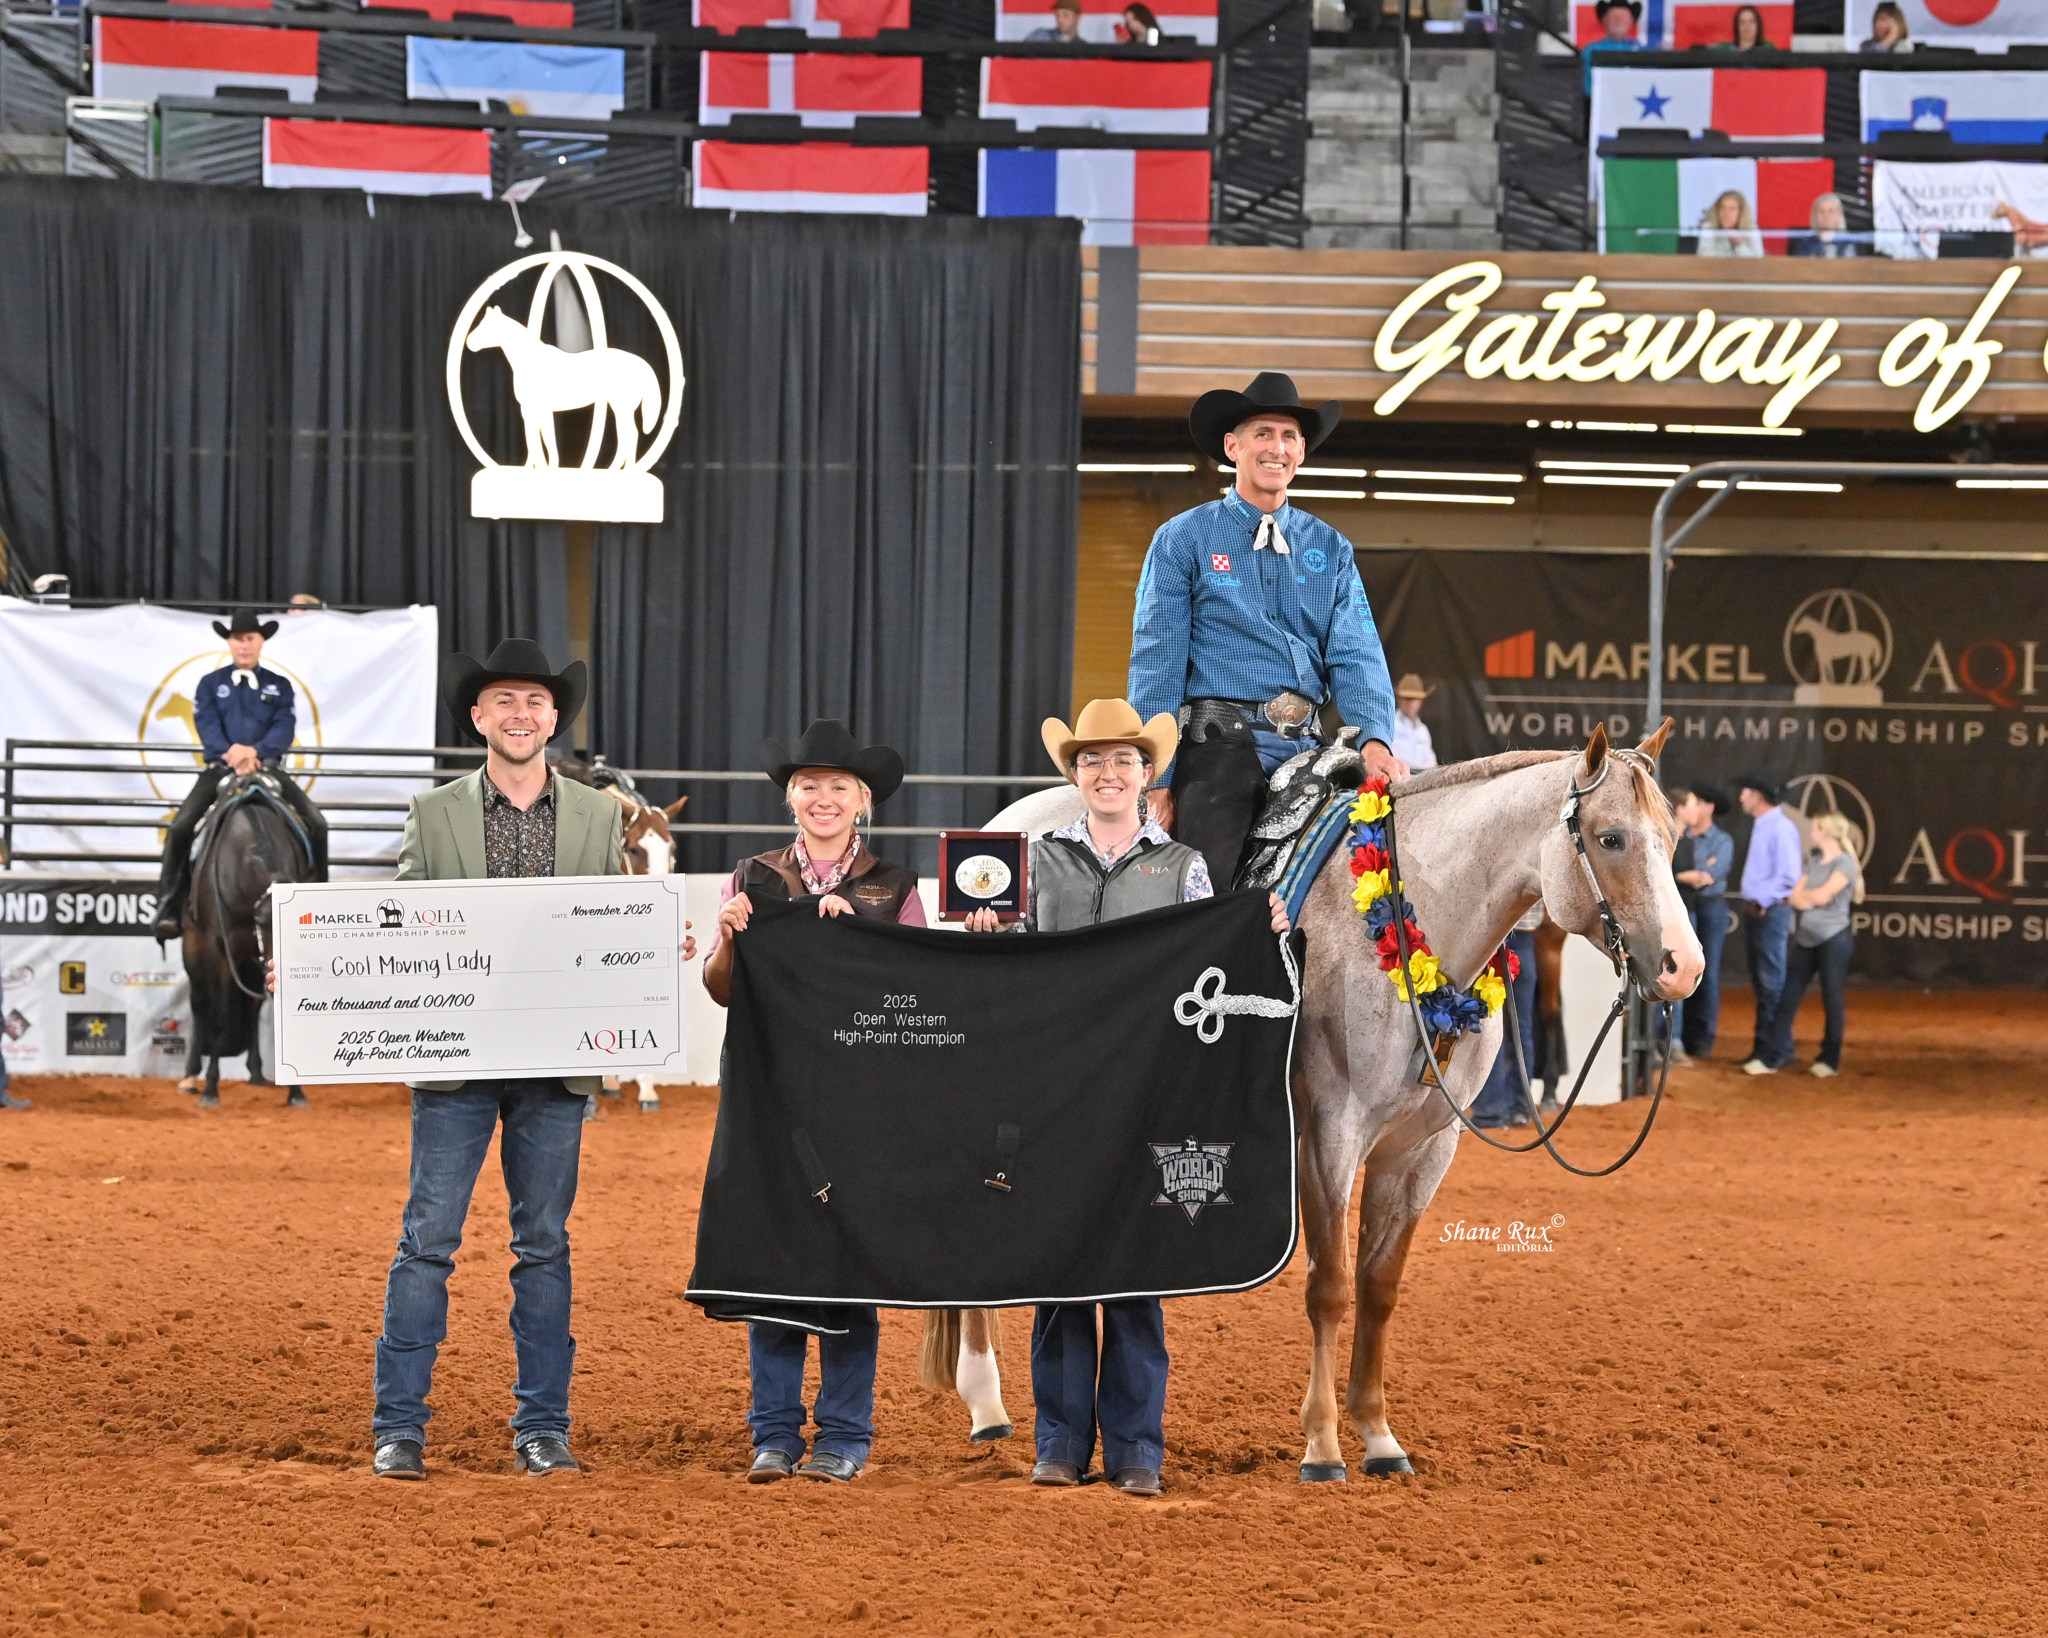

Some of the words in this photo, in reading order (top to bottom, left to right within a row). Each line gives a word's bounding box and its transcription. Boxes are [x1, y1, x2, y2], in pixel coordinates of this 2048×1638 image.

[1373, 260, 1842, 428] Gateway
[1878, 265, 2023, 433] of
[1485, 712, 1631, 738] WORLD
[1662, 715, 1984, 745] HAMPIONSHIP
[0, 892, 48, 924] ND
[55, 892, 158, 925] SPONS
[314, 913, 373, 925] MARKEL
[409, 909, 466, 926] AQHA
[570, 904, 622, 917] November
[623, 903, 655, 915] 2025
[344, 930, 430, 938] CHAMPIONSHIP
[435, 928, 467, 936] SHOW
[2022, 915, 2048, 942] S
[332, 955, 371, 977] Cool
[379, 955, 440, 979] Moving
[446, 948, 492, 977] Lady
[575, 954, 583, 968] $
[297, 997, 329, 1012] Four
[331, 995, 393, 1011] thousand
[393, 994, 422, 1009] and
[883, 994, 918, 1009] 2025
[853, 1011, 886, 1028] Open
[894, 1012, 947, 1027] Western
[338, 1030, 376, 1045] 2025
[377, 1029, 412, 1047] Open
[415, 1028, 466, 1043] Western
[575, 1028, 660, 1055] AQHA
[833, 1029, 898, 1046] High-Point
[901, 1030, 965, 1047] Champion
[333, 1045, 404, 1068] High-Point
[405, 1045, 471, 1062] Champion
[1162, 1157, 1224, 1189] WORLD
[1166, 1177, 1219, 1194] CHAMPIONSHIP
[1177, 1189, 1207, 1203] SHOW
